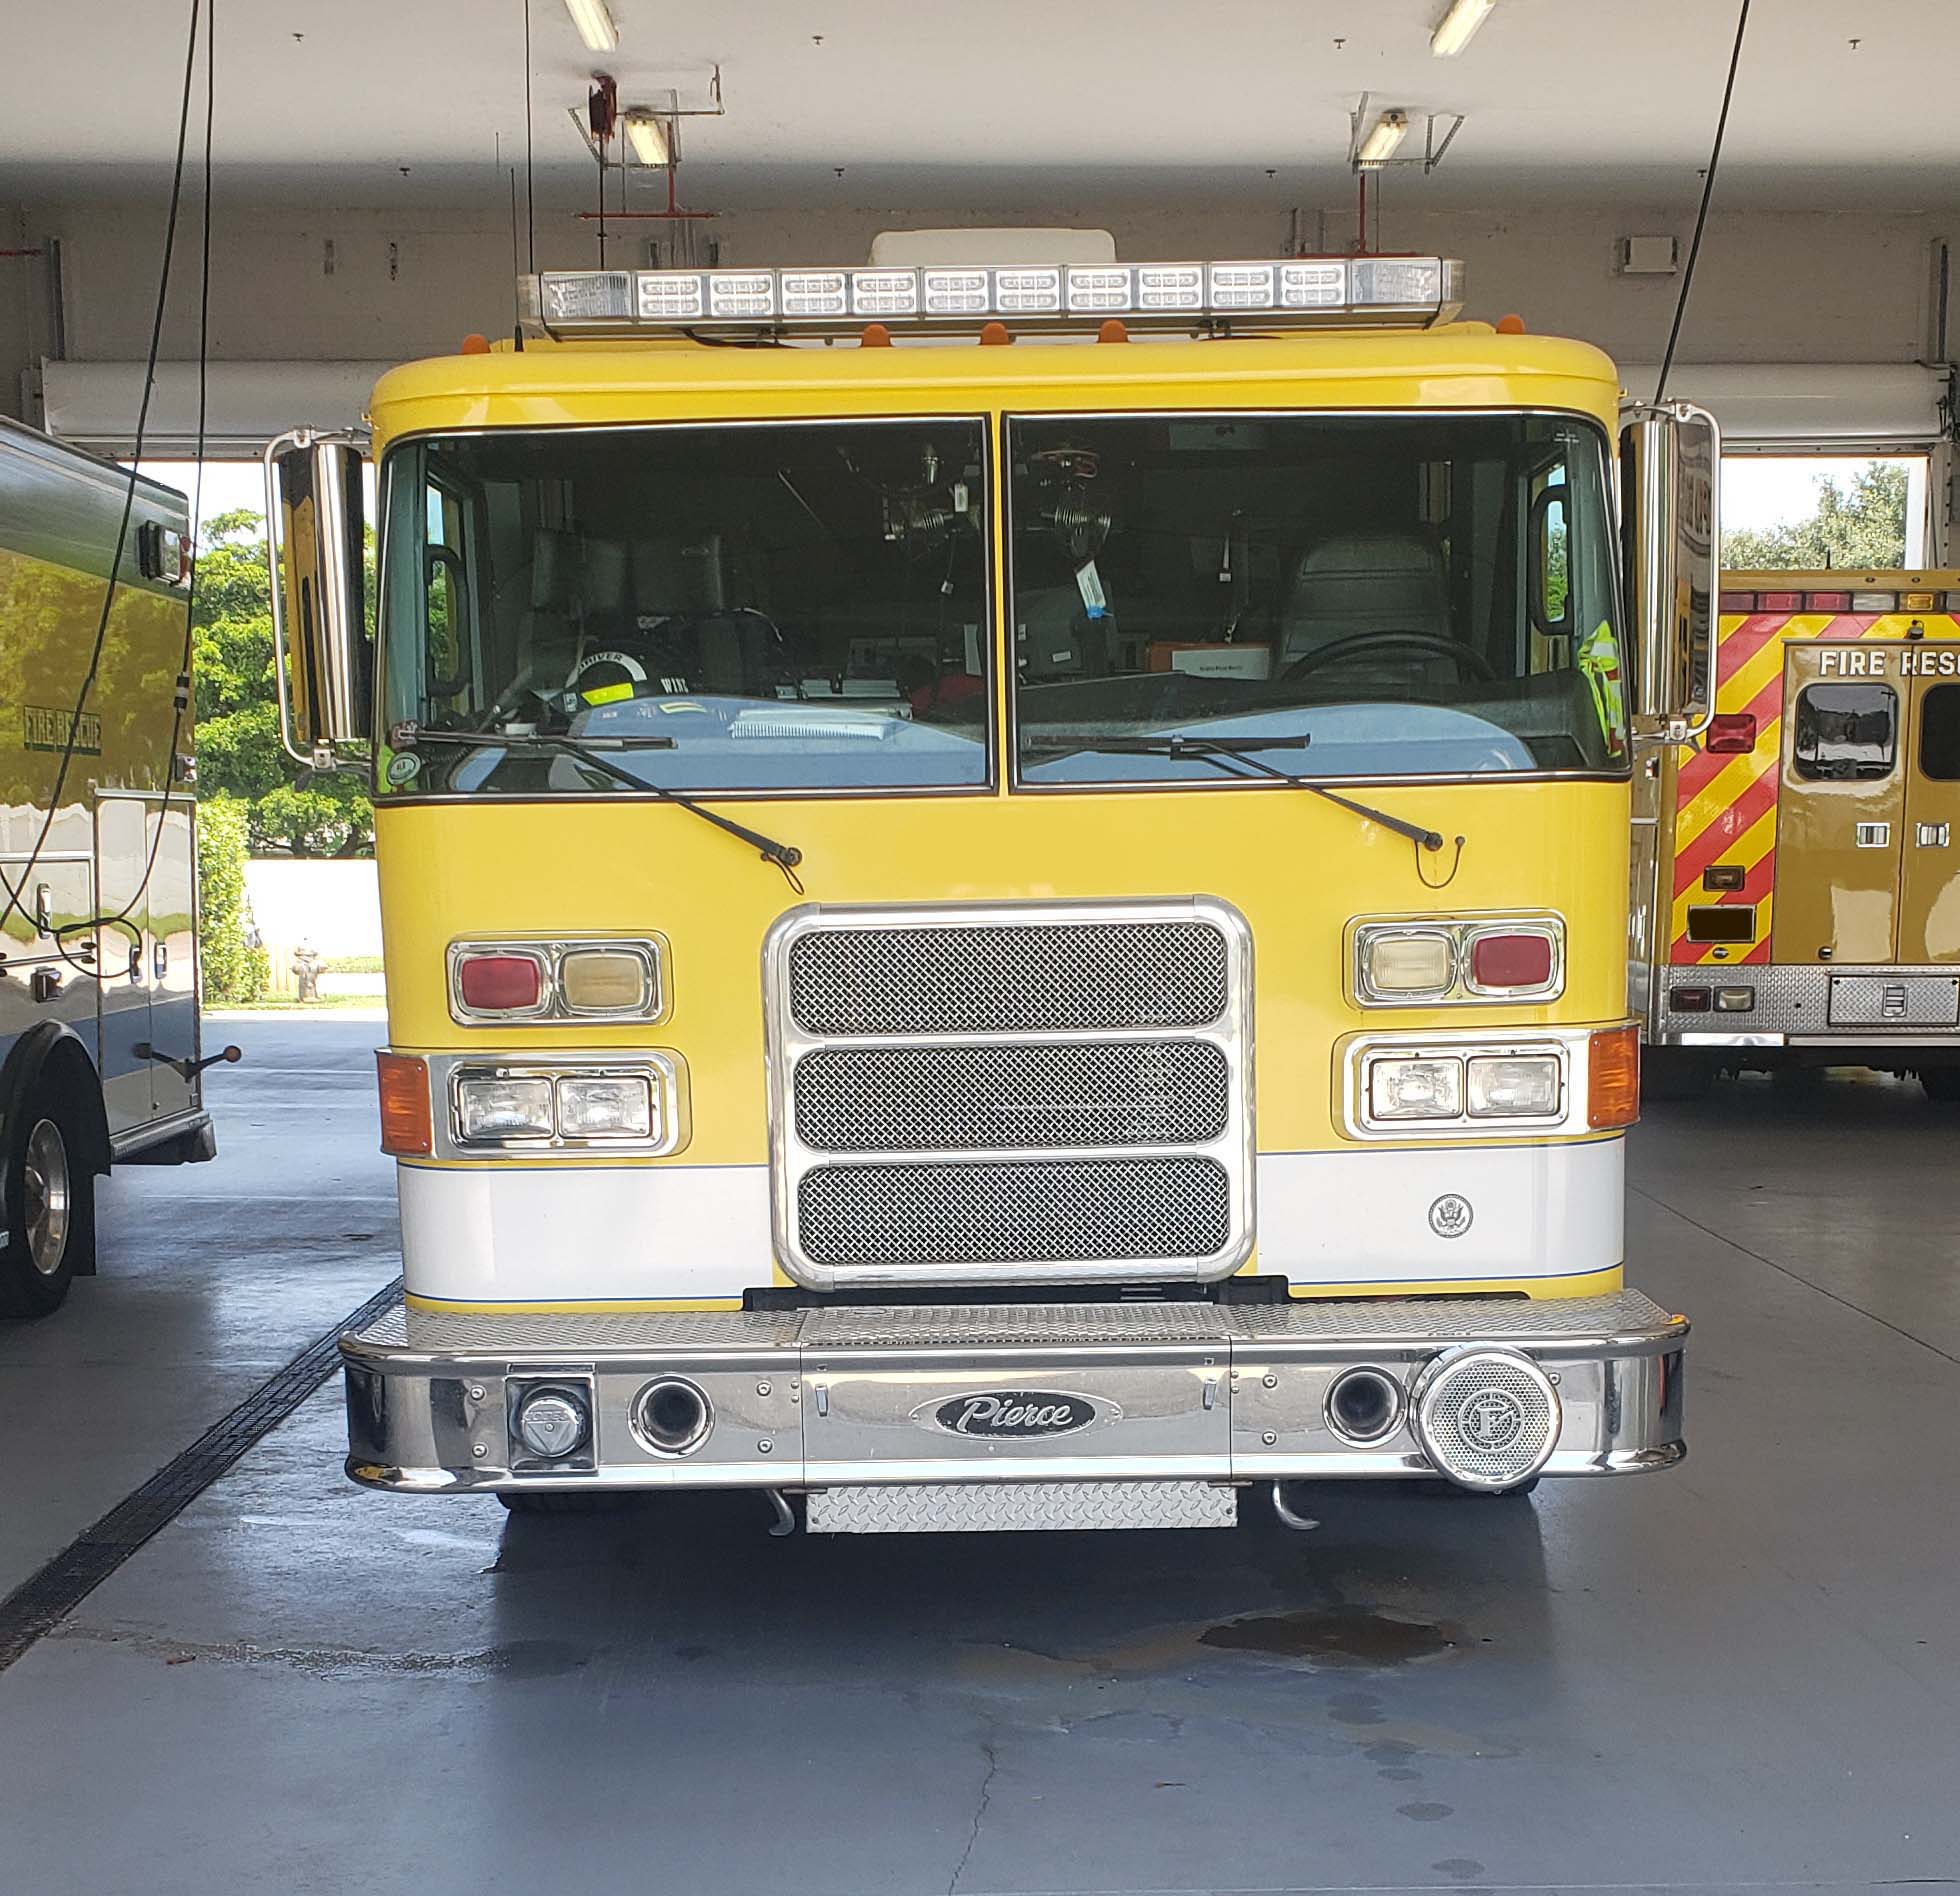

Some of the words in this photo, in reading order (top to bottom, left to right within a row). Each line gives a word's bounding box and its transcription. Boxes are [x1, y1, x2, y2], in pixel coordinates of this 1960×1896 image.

[1820, 651, 1886, 676] FIRE
[24, 706, 56, 745] FIRE
[956, 1396, 1073, 1433] Pierce
